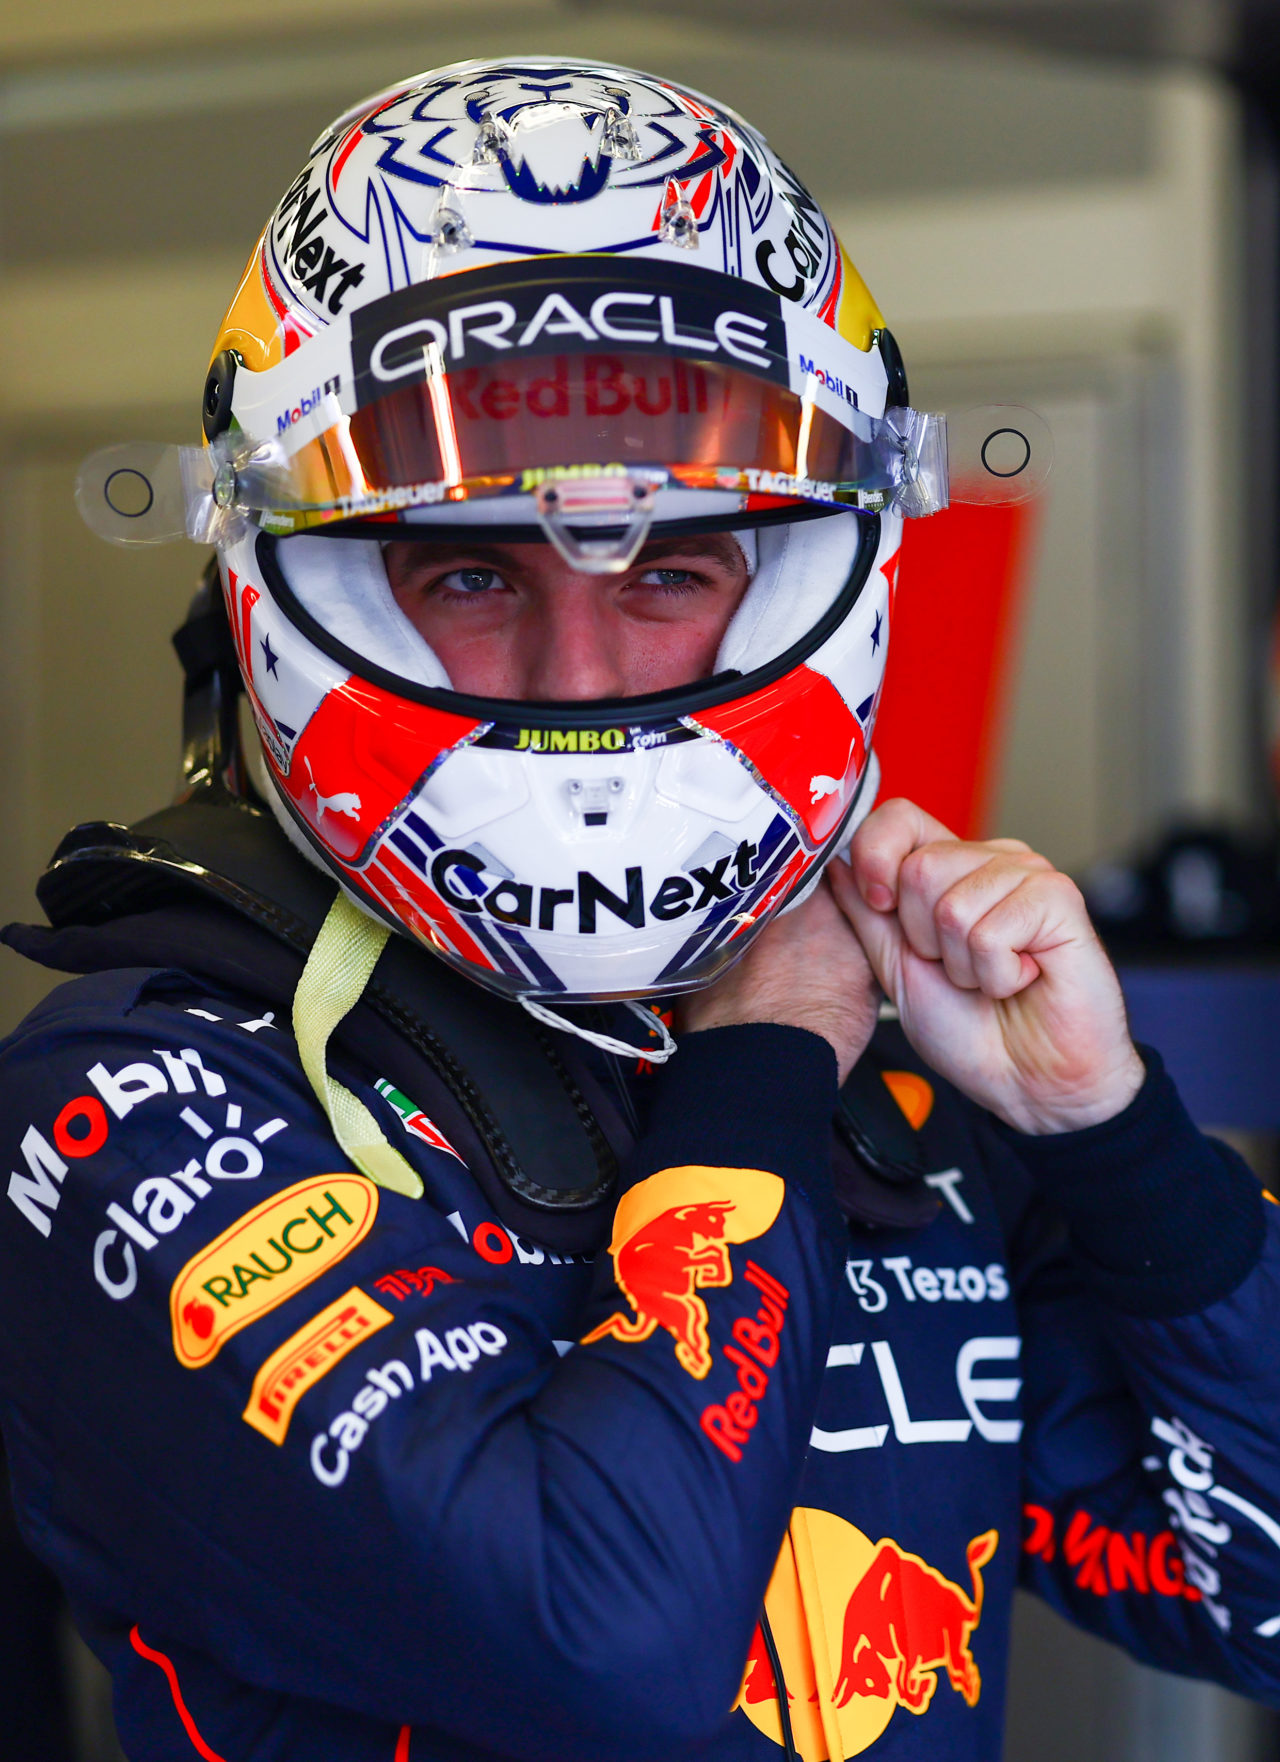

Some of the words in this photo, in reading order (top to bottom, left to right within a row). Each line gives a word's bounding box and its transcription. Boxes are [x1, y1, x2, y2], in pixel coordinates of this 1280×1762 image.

[277, 166, 366, 316] arNext
[370, 291, 770, 382] ORACLE
[450, 353, 570, 421] Red
[584, 353, 708, 417] Bull
[799, 354, 844, 400] Mobil
[276, 386, 321, 434] Mobil
[430, 836, 760, 935] CarNext
[93, 1136, 264, 1300] Claro
[202, 1191, 355, 1308] RAUCH
[731, 1260, 790, 1368] Bull
[882, 1256, 1010, 1302] Tezos
[258, 1305, 371, 1424] PIRELLI
[310, 1360, 415, 1488] Cash
[414, 1321, 508, 1383] App
[700, 1344, 769, 1463] Red
[810, 1336, 1024, 1453] CLE
